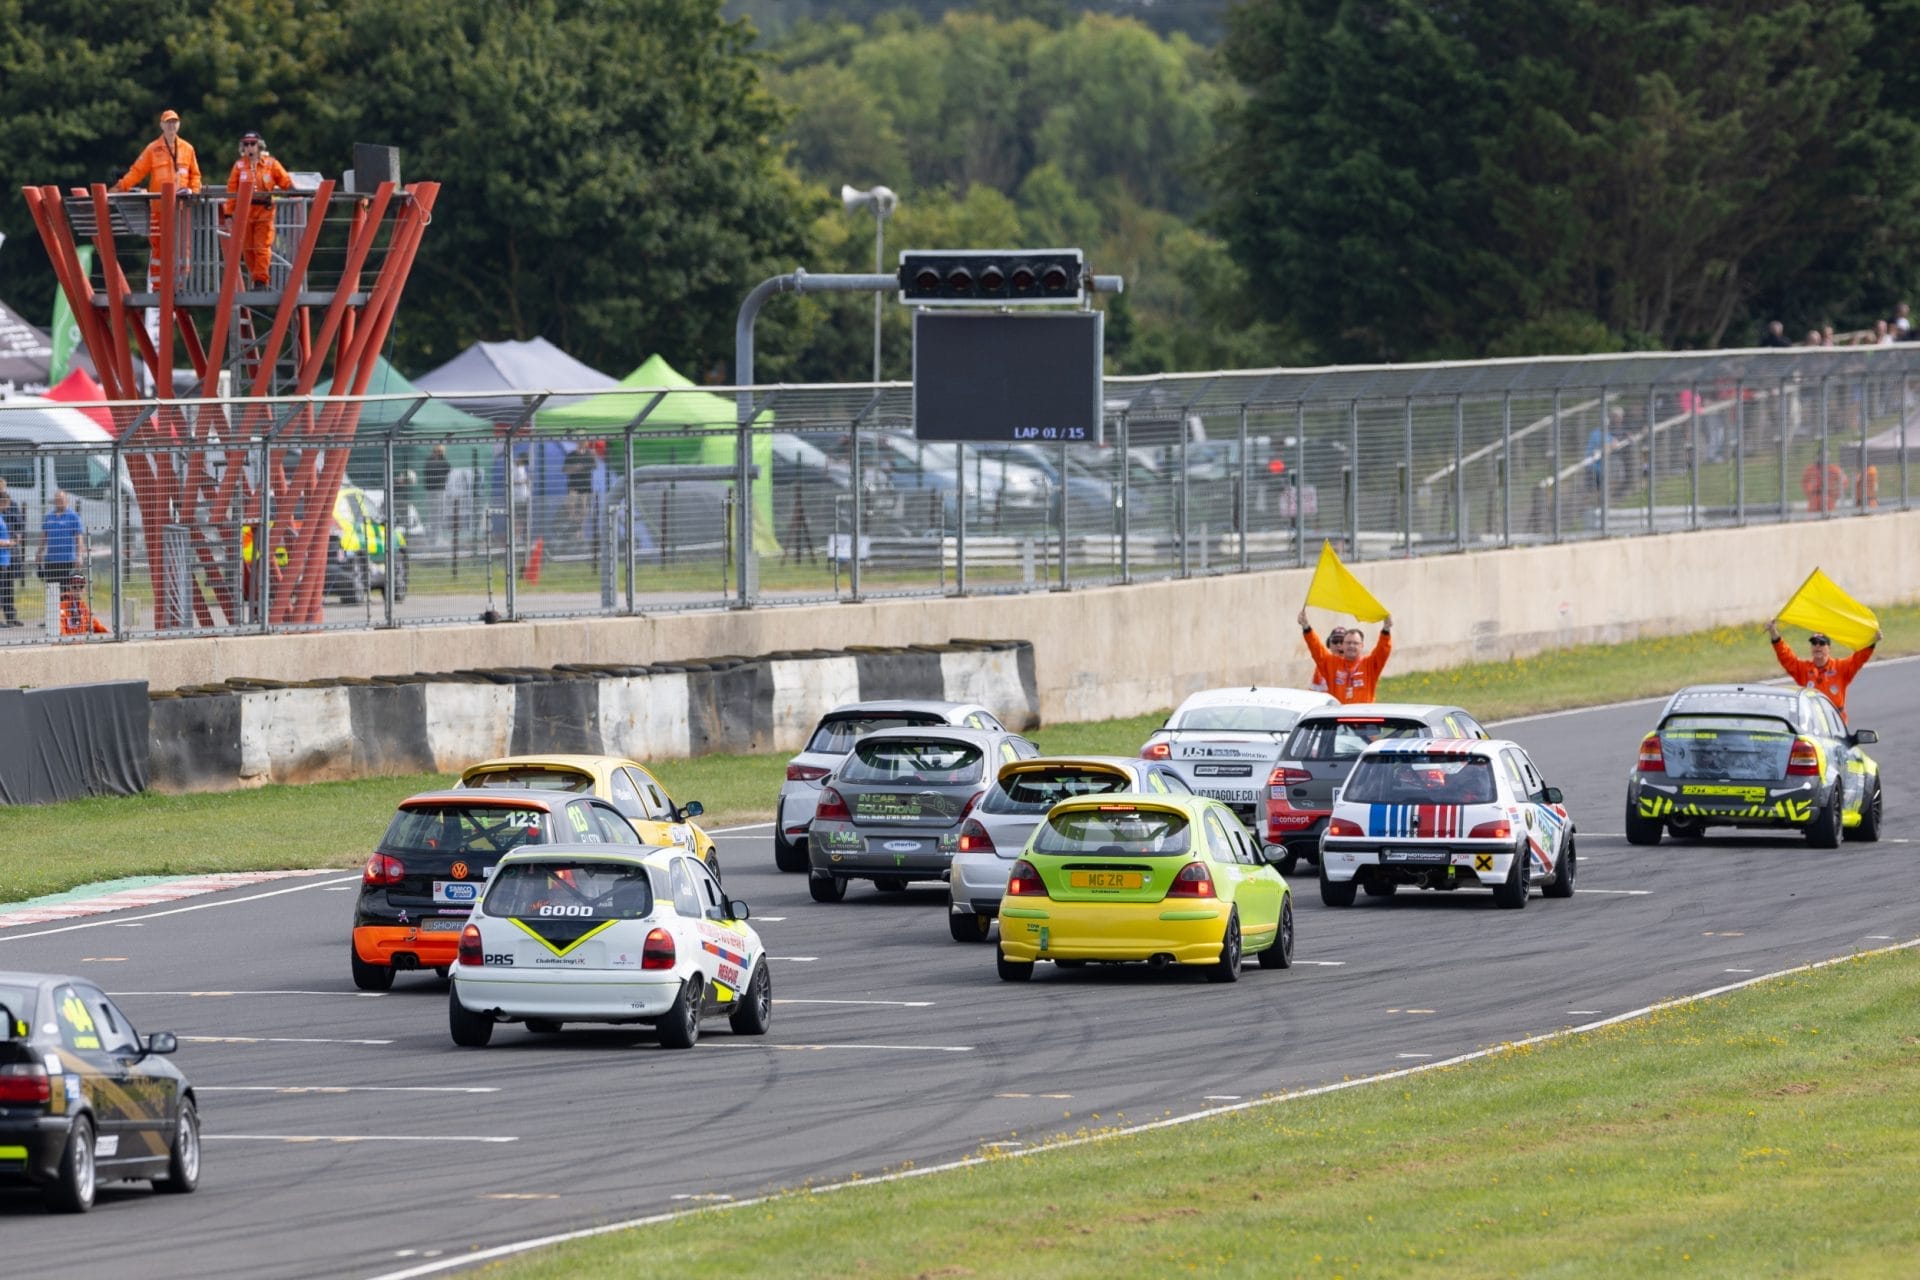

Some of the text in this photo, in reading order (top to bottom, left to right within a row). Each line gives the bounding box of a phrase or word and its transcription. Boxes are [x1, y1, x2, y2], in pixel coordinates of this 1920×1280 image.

[1014, 426, 1085, 439] LAP 01 / 15
[872, 795, 896, 803] CAR
[857, 804, 921, 814] SOLUTIONS
[505, 811, 540, 828] 123
[1280, 815, 1310, 825] concept
[1088, 874, 1124, 887] MG ZR
[539, 905, 594, 917] GOOD
[484, 953, 514, 966] PRS
